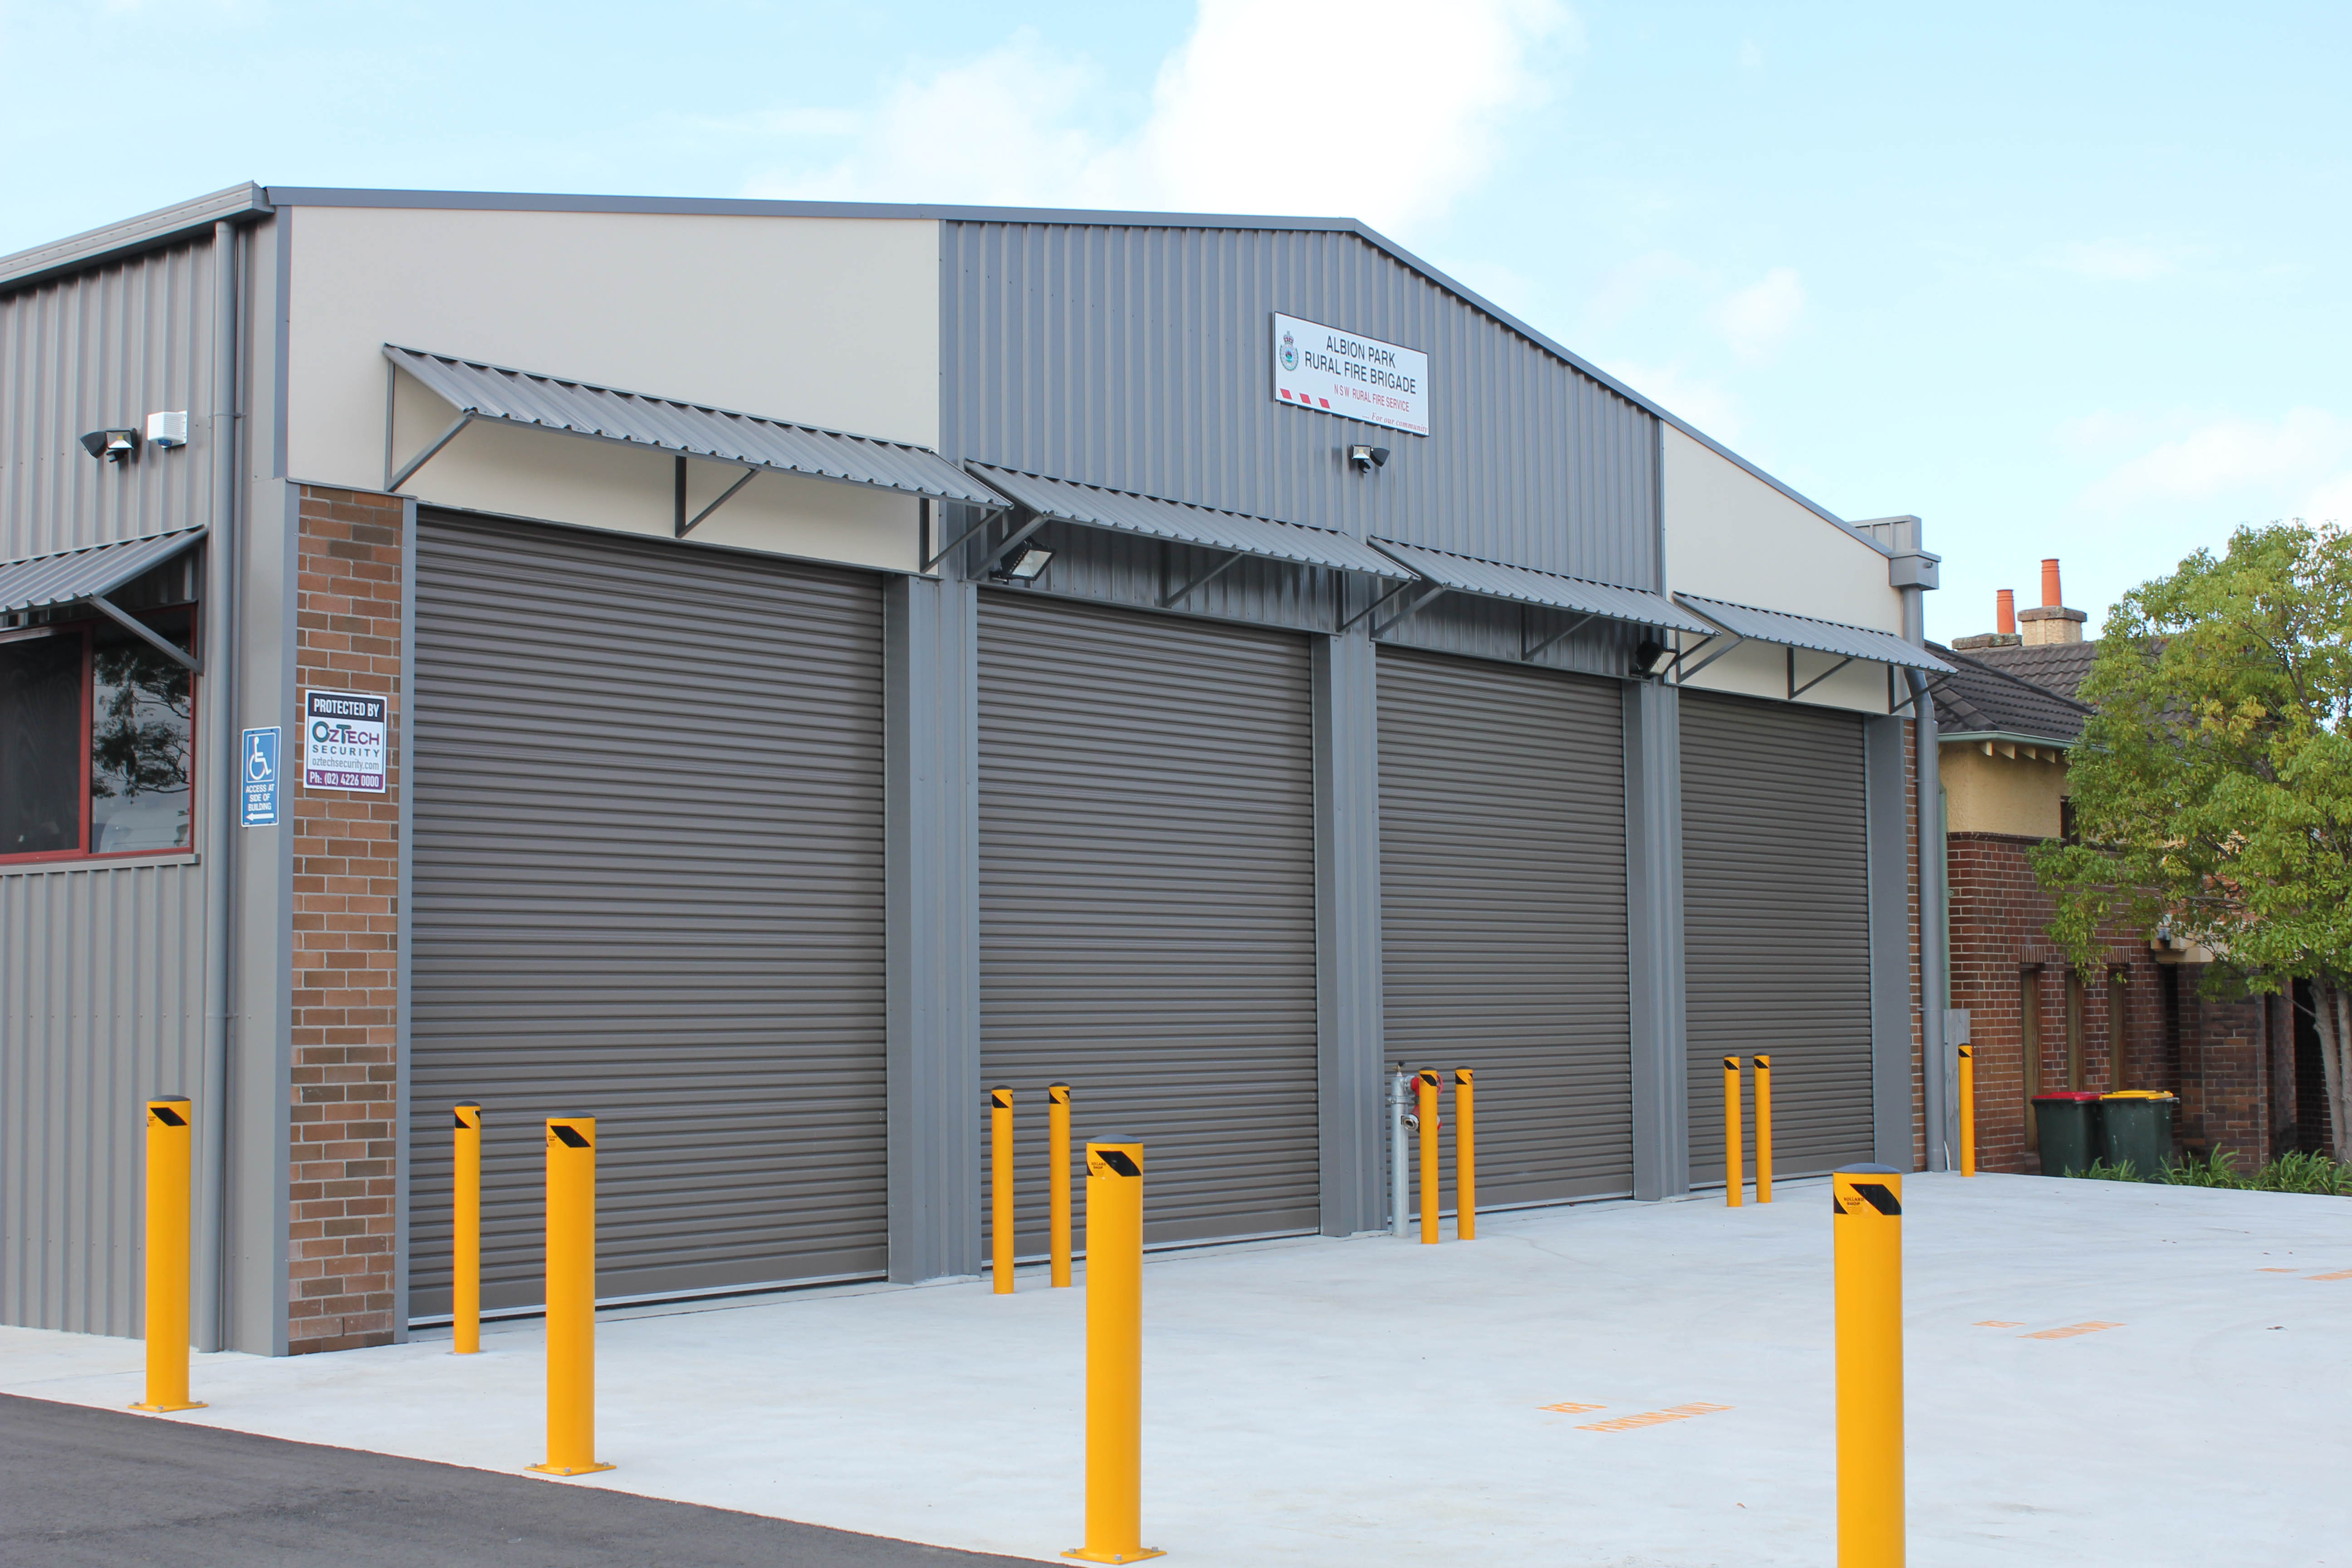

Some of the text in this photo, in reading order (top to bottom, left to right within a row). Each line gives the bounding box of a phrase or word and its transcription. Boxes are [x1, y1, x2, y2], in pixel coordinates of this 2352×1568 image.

[1326, 335, 1396, 368] ALBION PARK
[1305, 351, 1341, 375] RURAL
[1344, 361, 1367, 382] FIRE
[1371, 368, 1416, 394] BRIGADE
[1352, 388, 1371, 403] RURAL
[1372, 393, 1384, 407] FIRE
[1386, 397, 1410, 412] SERVICE
[1372, 412, 1383, 421] For
[1396, 419, 1428, 434] community
[314, 698, 380, 717] PROTECTED BY
[312, 745, 380, 758] SECURITY
[312, 756, 379, 771] oztechsecurity.com
[310, 772, 379, 787] Ph: (02) 4226 0000
[245, 784, 275, 793] ACCESS AT
[249, 793, 271, 802] SIDE OF
[248, 803, 272, 811] BUILDING
